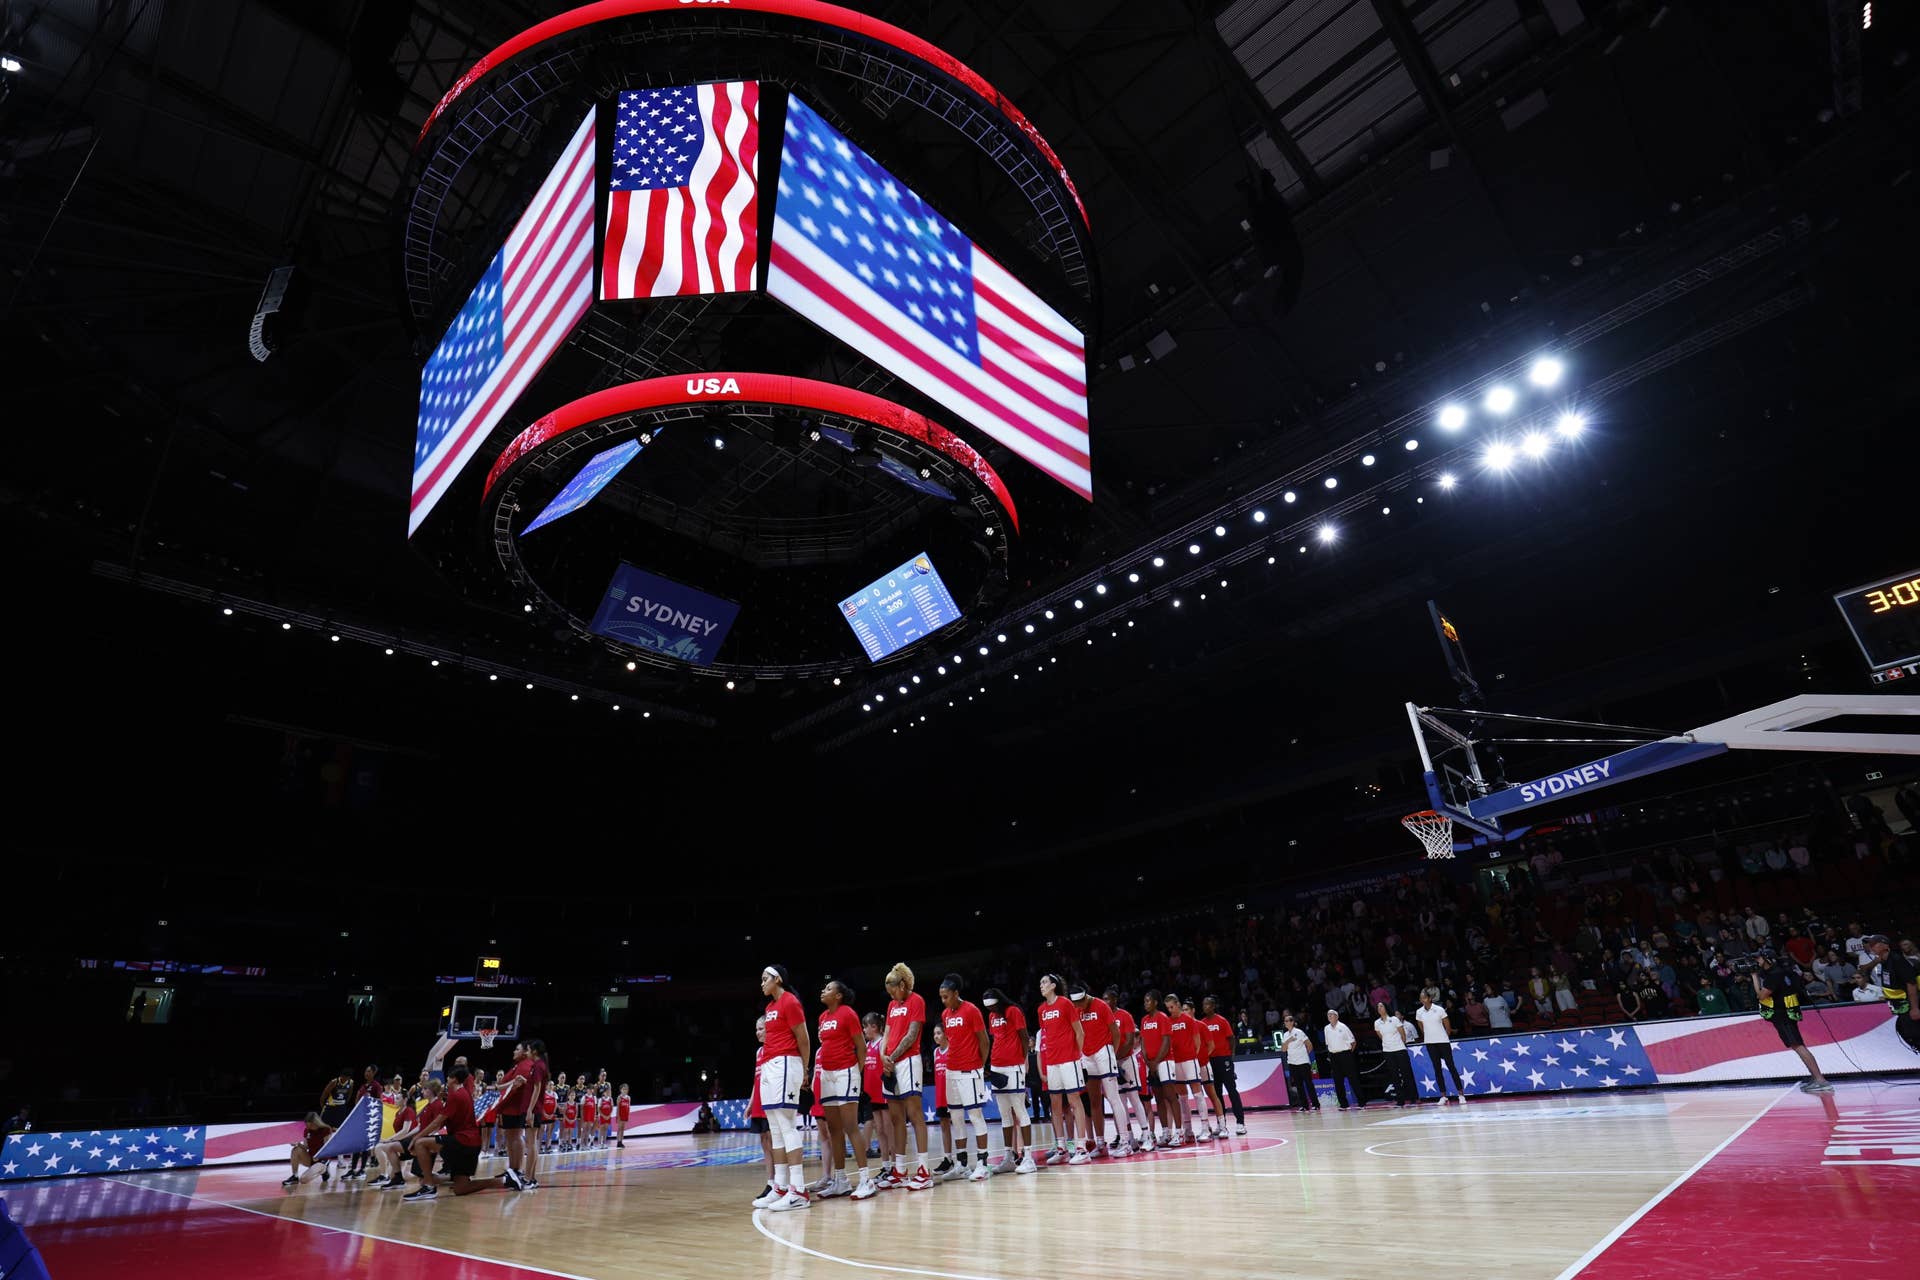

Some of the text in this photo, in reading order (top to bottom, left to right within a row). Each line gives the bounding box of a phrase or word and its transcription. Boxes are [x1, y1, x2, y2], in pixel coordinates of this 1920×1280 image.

[686, 377, 741, 395] USA
[625, 596, 719, 637] SYDNEY
[1520, 760, 1610, 802] SYDNEY
[890, 1007, 907, 1018] USA
[1042, 1010, 1059, 1021] USA
[945, 1017, 963, 1028] USA
[1143, 1021, 1158, 1030] USA
